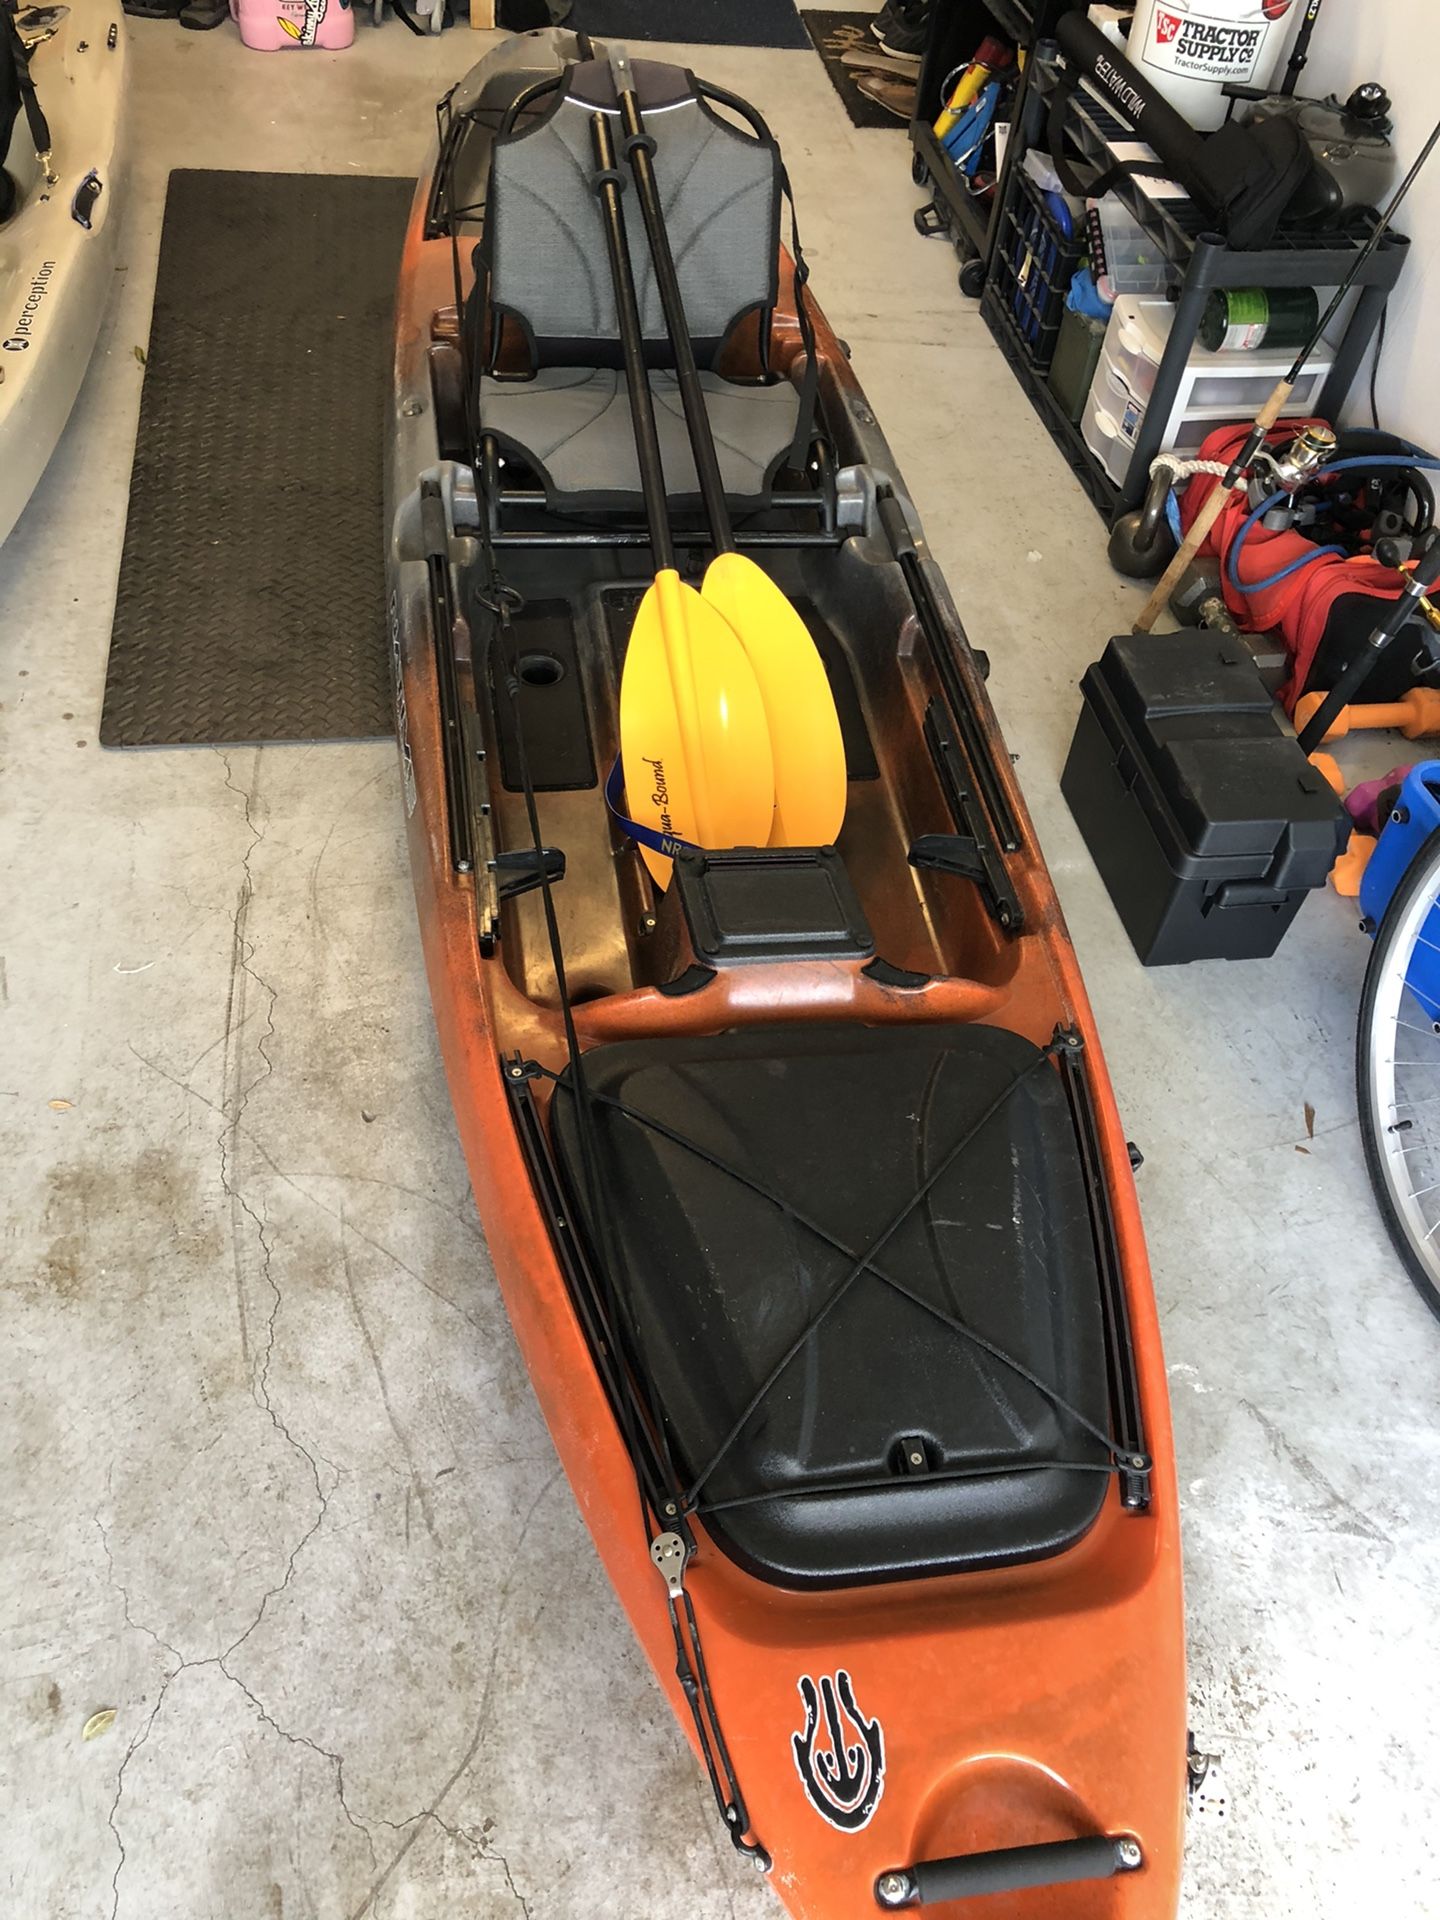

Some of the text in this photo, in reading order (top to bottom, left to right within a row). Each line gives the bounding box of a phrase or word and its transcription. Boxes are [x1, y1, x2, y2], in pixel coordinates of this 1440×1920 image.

[1157, 12, 1175, 40] TSC
[1182, 20, 1260, 47] TRACTOR
[1176, 38, 1240, 63] SUPPLY
[1174, 56, 1249, 75] TractorSupply.com
[1095, 61, 1146, 119] WILDWATER
[14, 261, 56, 335] perception
[642, 757, 683, 837] qua-Bound
[661, 838, 682, 855] NR
